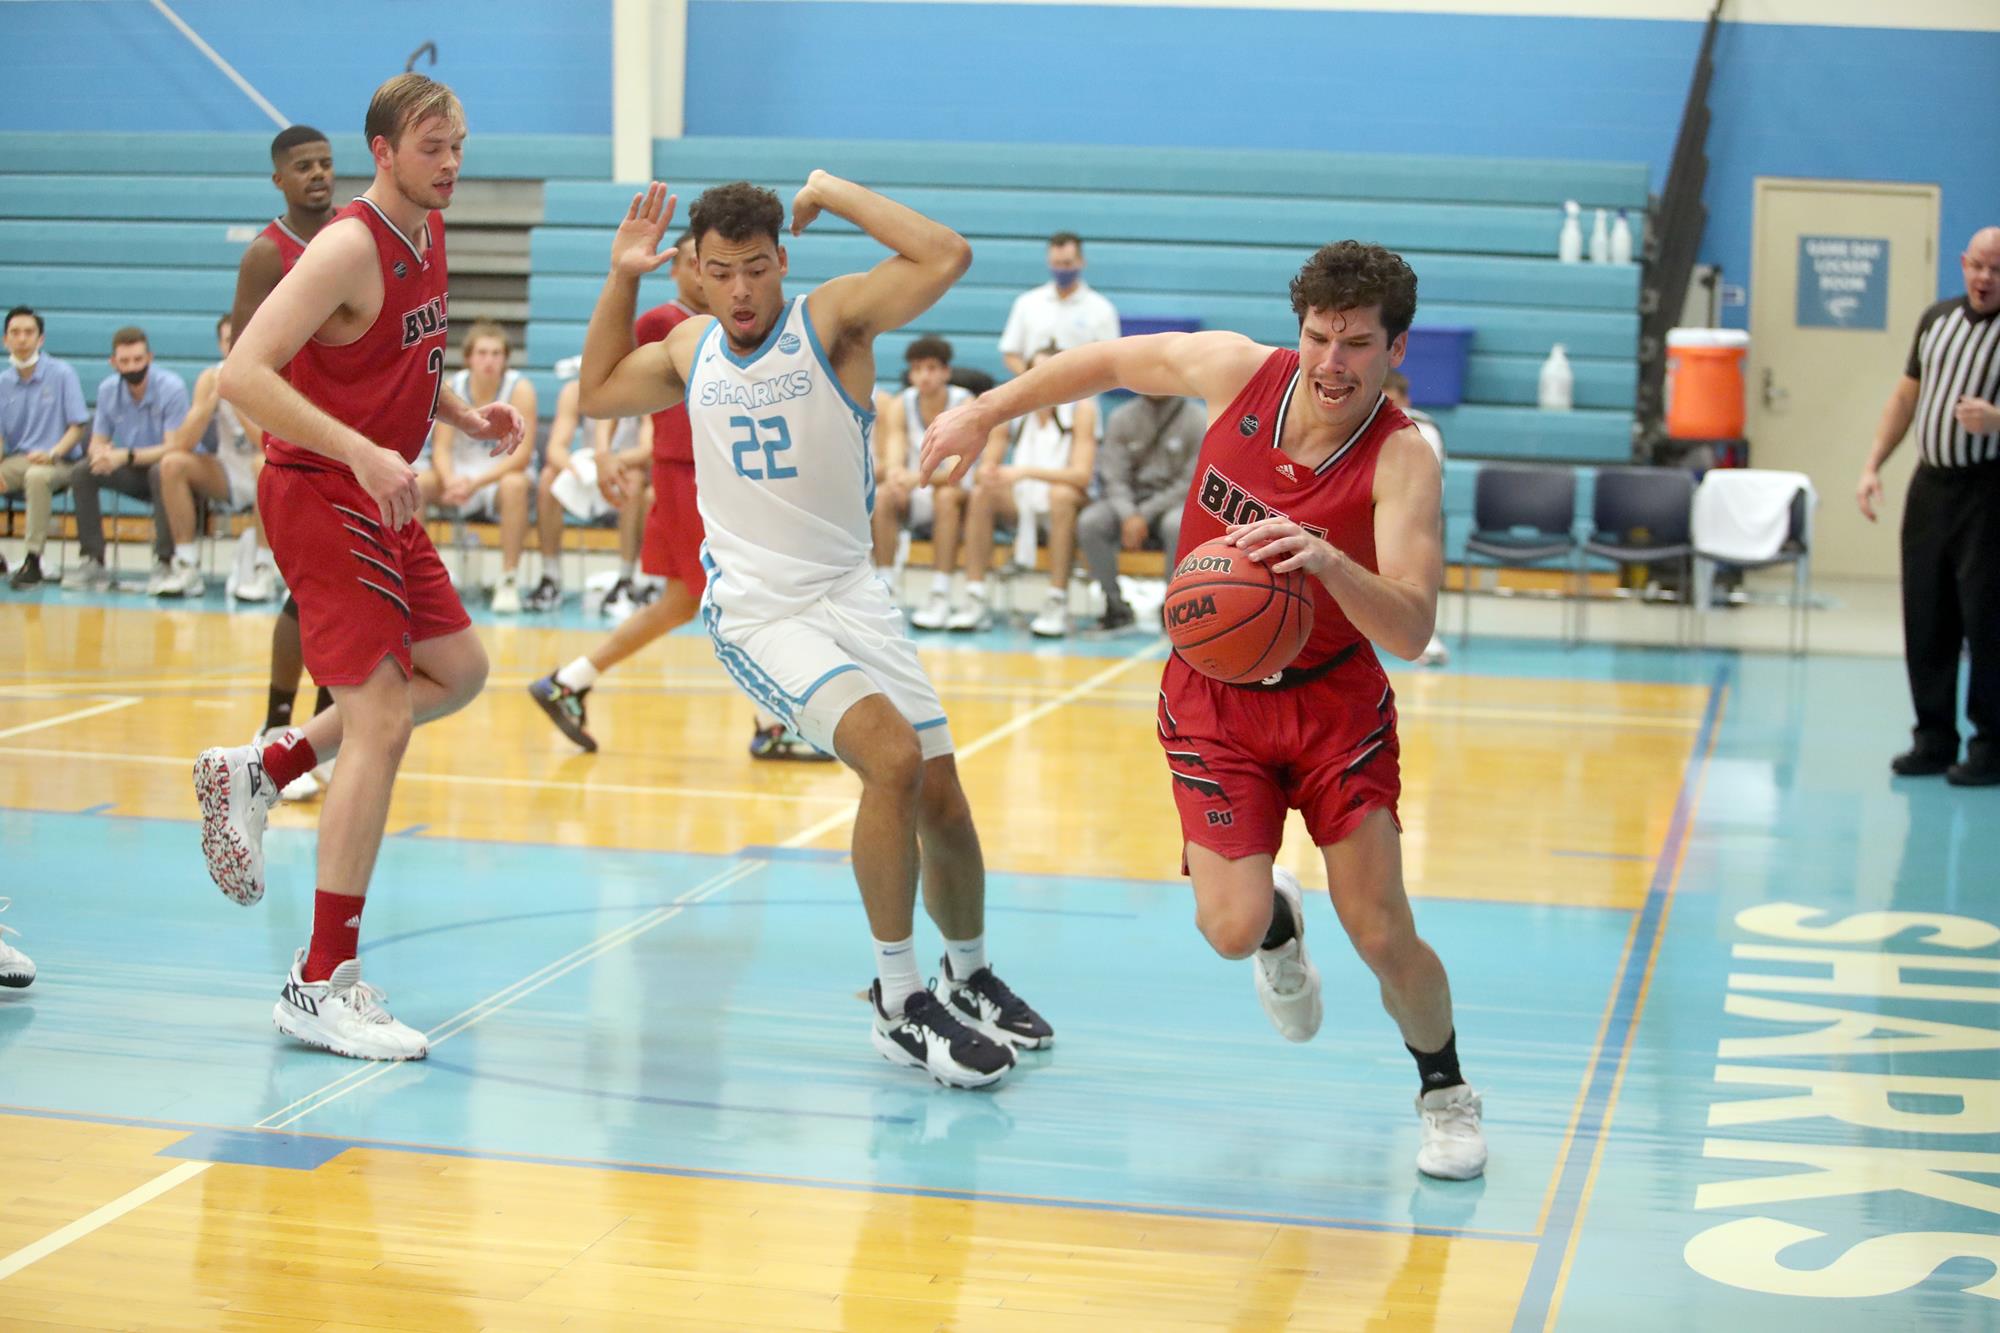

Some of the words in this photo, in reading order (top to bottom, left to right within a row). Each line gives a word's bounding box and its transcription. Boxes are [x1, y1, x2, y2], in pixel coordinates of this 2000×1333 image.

[700, 370, 812, 410] SHARKS
[730, 415, 798, 480] 22
[1198, 463, 1328, 540] BIO
[1168, 593, 1217, 629] NCAA
[1204, 808, 1234, 827] BU
[1683, 901, 2000, 1300] SHARKS
